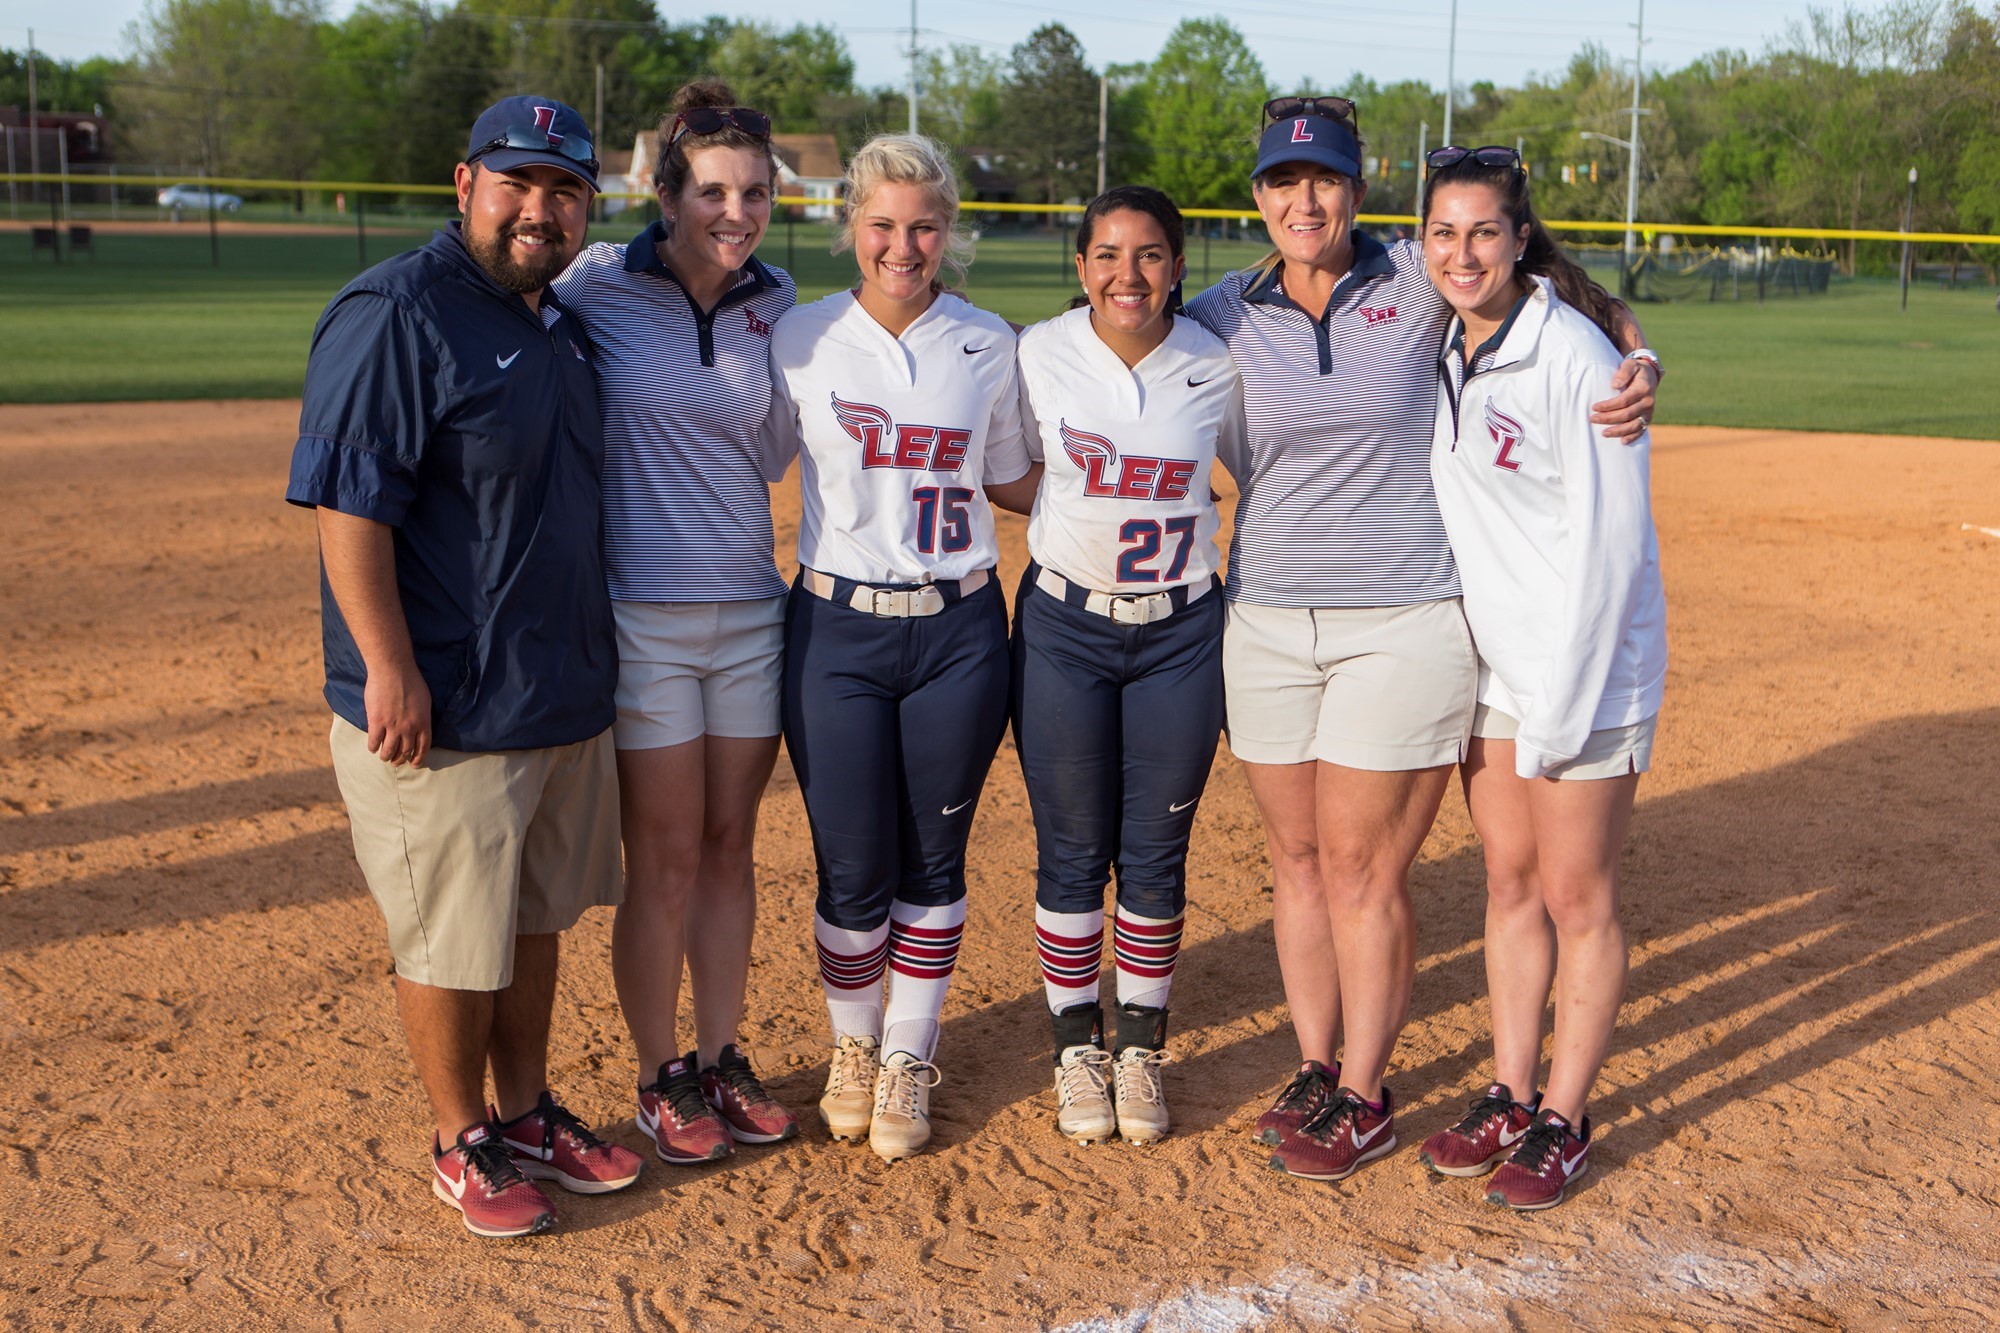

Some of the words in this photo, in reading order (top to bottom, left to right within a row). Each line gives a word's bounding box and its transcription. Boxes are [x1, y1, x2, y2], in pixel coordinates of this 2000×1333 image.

[1291, 119, 1313, 143] L
[861, 424, 972, 472] LEE
[1493, 433, 1523, 473] L
[1084, 455, 1198, 501] LEE
[912, 486, 975, 554] 15
[1116, 516, 1199, 583] 27
[467, 1126, 486, 1143] NIKE
